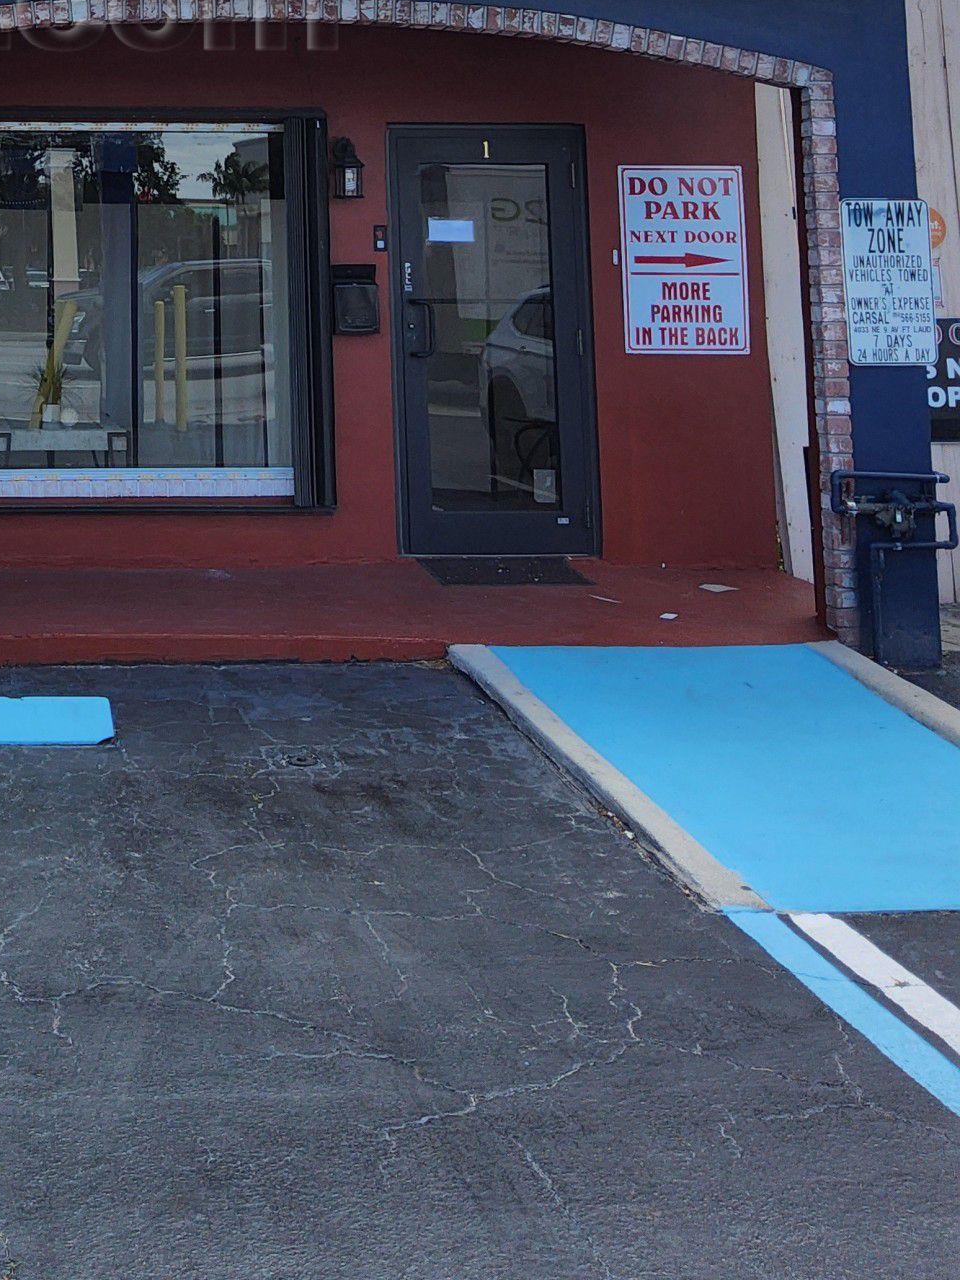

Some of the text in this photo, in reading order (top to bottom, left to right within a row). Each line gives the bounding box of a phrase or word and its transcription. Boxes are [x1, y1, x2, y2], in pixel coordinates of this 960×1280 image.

[483, 140, 490, 158] 1
[628, 177, 733, 196] DO NOT
[644, 200, 721, 220] PARK
[845, 201, 923, 228] TOW AWAY
[630, 230, 737, 244] NEXT DOOR
[868, 228, 906, 254] ZONE
[853, 255, 922, 269] UNAUTHORIZED
[849, 269, 929, 282] VEHICLES TOWED
[661, 282, 711, 301] MORE
[883, 284, 894, 296] AT
[851, 297, 930, 311] OWNER'S EXPENSE
[651, 304, 723, 324] PARKING
[852, 311, 890, 325] CARSAL
[635, 327, 739, 346] IN THE BACK
[873, 335, 913, 348] 7 DAYS
[858, 349, 931, 362] 24 HOURS A DAY
